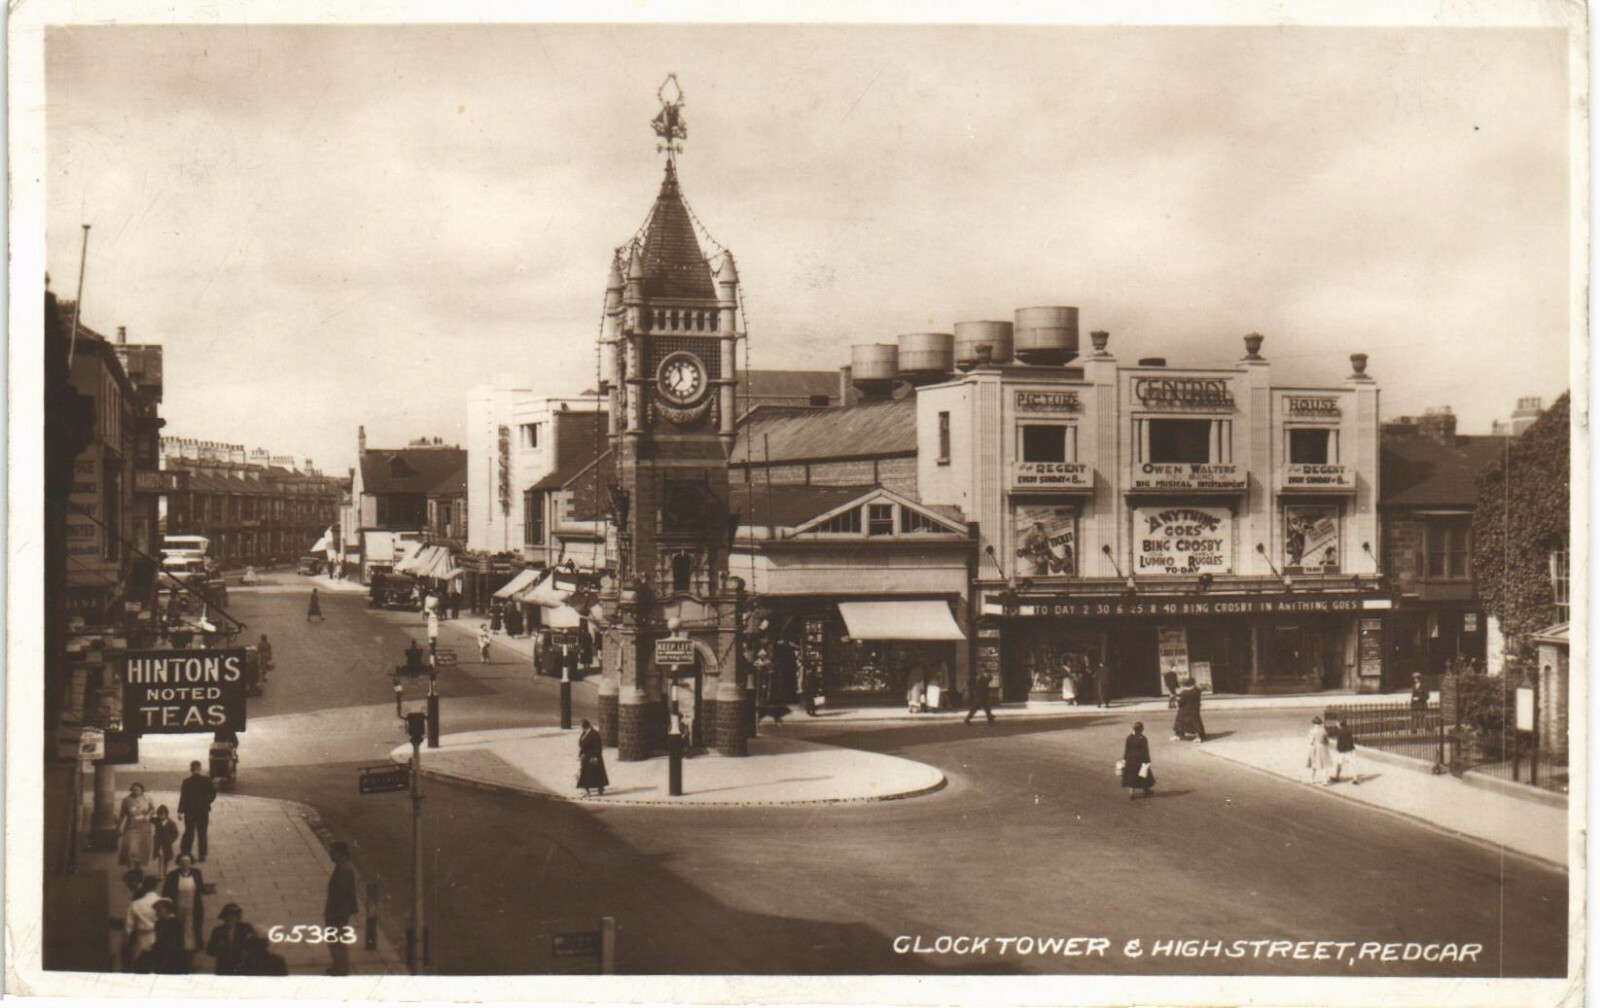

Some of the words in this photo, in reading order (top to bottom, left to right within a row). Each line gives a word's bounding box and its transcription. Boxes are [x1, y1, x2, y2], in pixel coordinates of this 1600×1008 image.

[1135, 379, 1231, 402] CENTRAL
[1017, 393, 1079, 407] PICTURE
[1289, 399, 1338, 411] HOUSE
[1036, 464, 1087, 474] REGENT
[1142, 463, 1182, 474] OWEN
[1190, 464, 1237, 474] WALTERS
[1302, 465, 1345, 475] REGENT
[1136, 480, 1150, 488] BIG
[1155, 480, 1193, 488] MUSICAL
[1143, 540, 1171, 552] BING
[1175, 539, 1224, 552] CROSBY
[1188, 555, 1223, 567] RUGGLES
[1036, 605, 1048, 615] TO
[1054, 605, 1075, 615] DAY
[1083, 604, 1090, 614] 2
[1097, 604, 1110, 614] 30
[1117, 604, 1124, 614] 6
[1150, 604, 1157, 613] 8
[1163, 604, 1177, 614] 40
[1183, 603, 1209, 613] BING
[1214, 602, 1252, 613] CROSBY
[1260, 602, 1273, 611] IN
[1332, 600, 1358, 610] GOES
[658, 643, 676, 651] KEEP
[127, 655, 241, 683] HINTON'S
[146, 687, 221, 701] NOTED
[139, 705, 227, 727] TEAS
